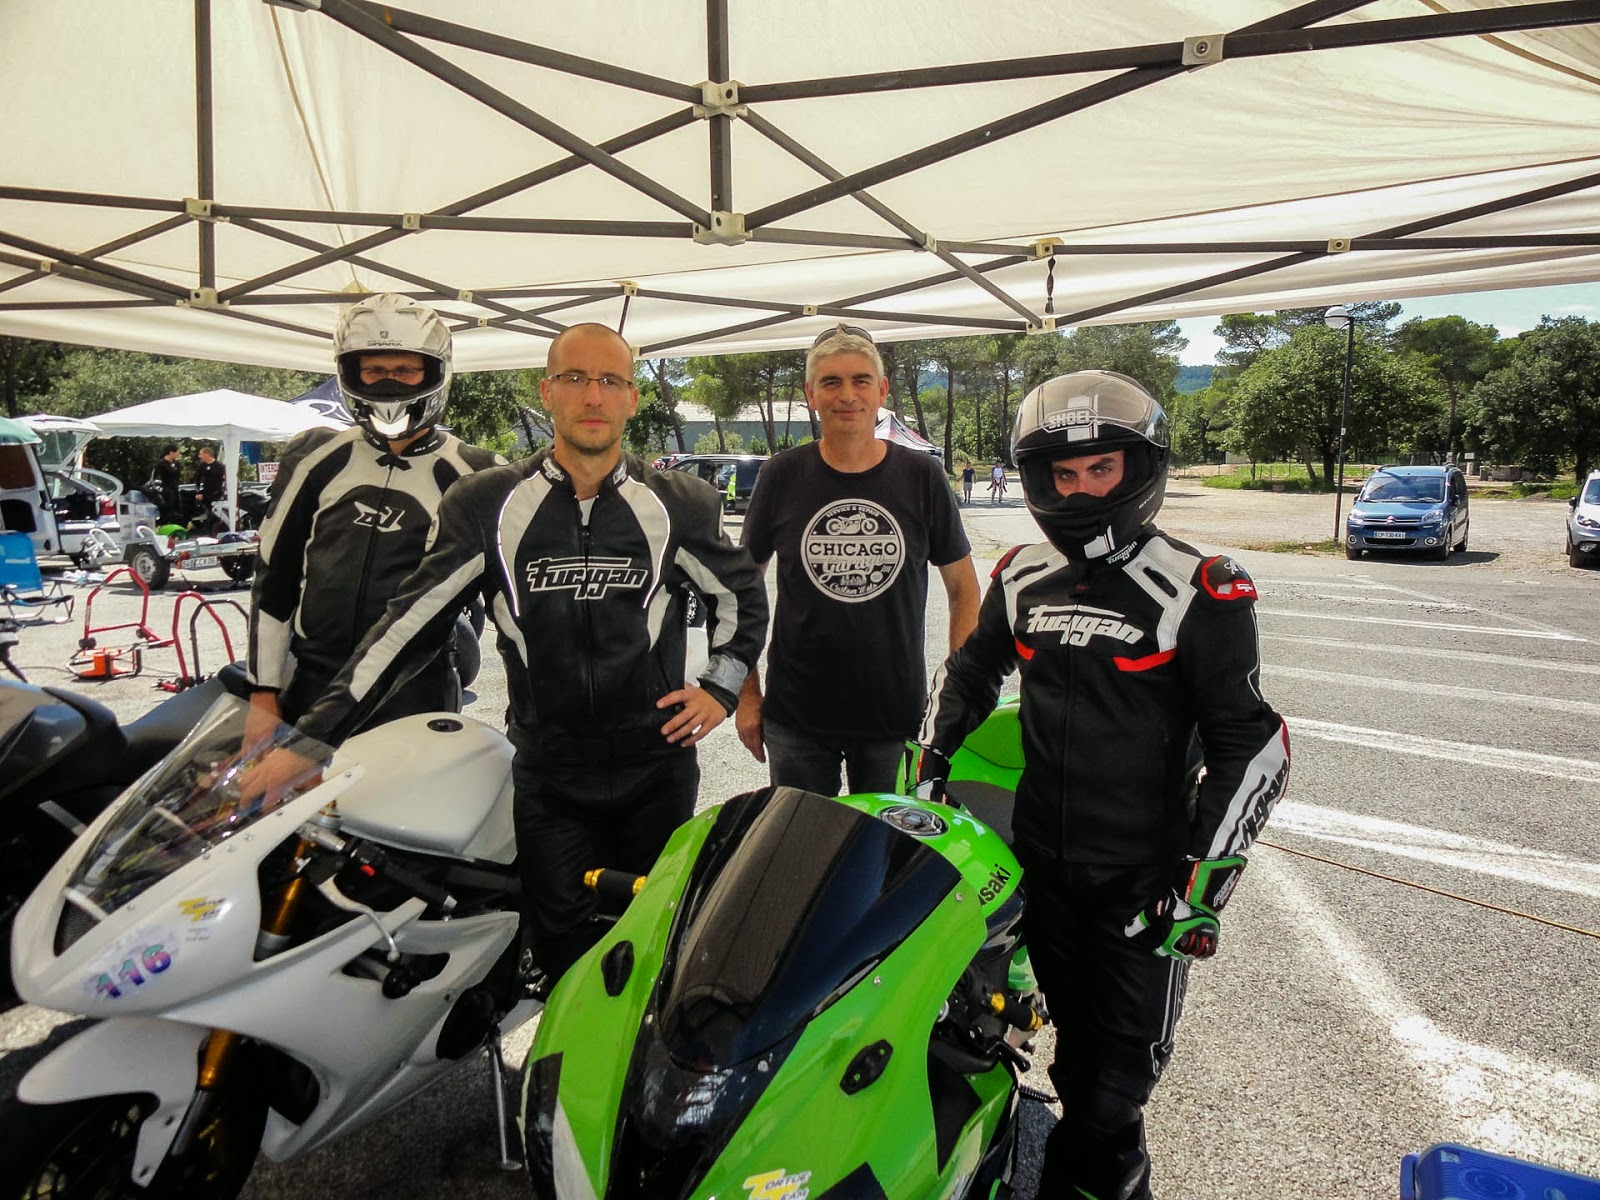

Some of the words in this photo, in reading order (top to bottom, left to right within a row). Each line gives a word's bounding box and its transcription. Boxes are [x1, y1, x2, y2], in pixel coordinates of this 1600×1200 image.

[1048, 410, 1090, 430] SHOEI
[259, 463, 279, 473] INTERD
[826, 506, 851, 518] SERVICE
[858, 506, 880, 518] REPAIR
[808, 542, 898, 556] CHICAGO
[96, 943, 172, 999] 116
